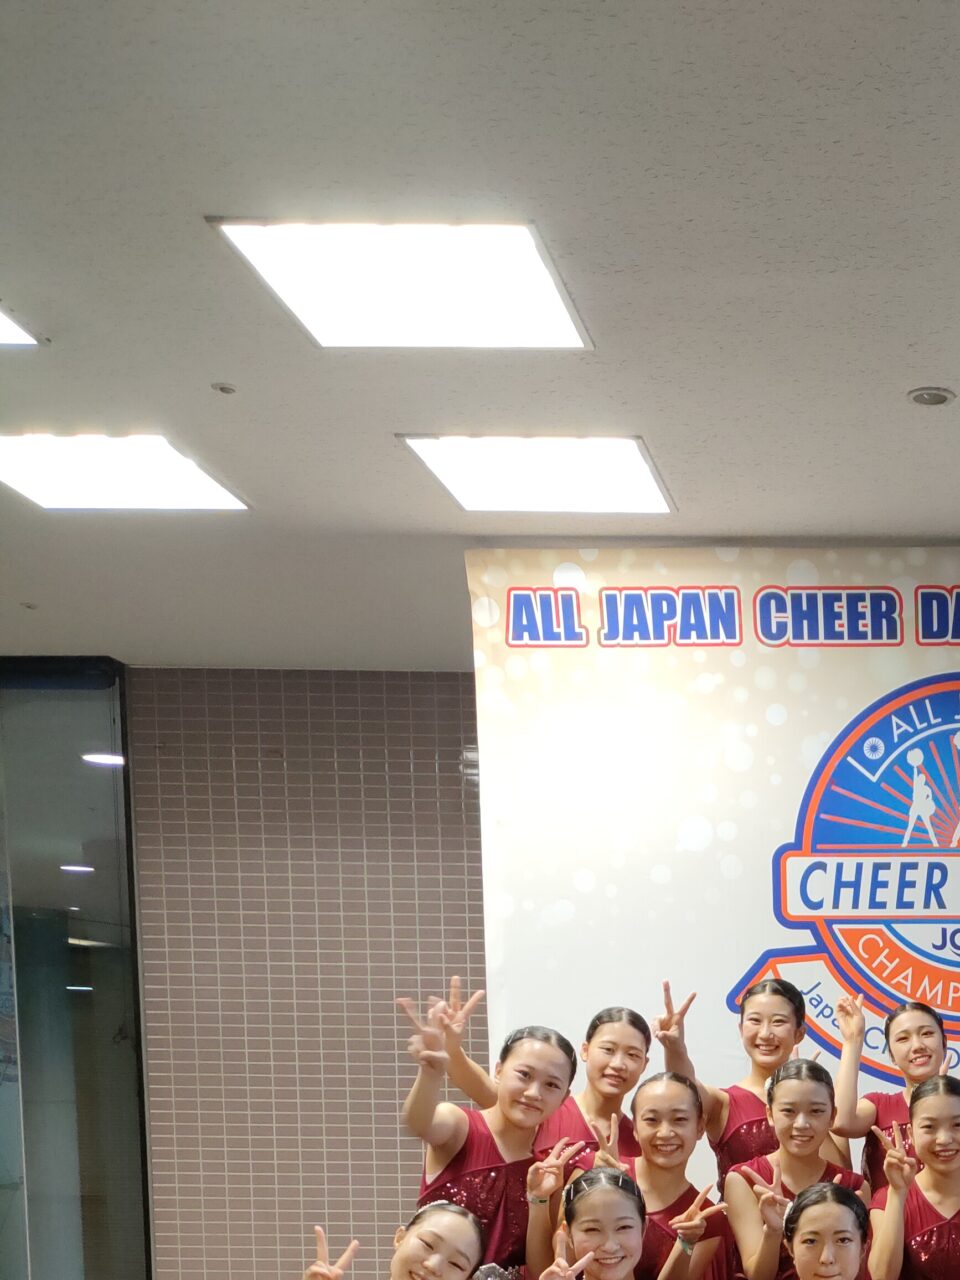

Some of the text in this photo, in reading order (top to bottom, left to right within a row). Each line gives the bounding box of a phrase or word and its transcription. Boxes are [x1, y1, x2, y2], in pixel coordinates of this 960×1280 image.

[509, 590, 586, 645] ALL
[600, 589, 740, 644] JAPAN
[756, 588, 900, 643] CHEER
[891, 699, 942, 743] ALL
[799, 860, 949, 911] CHEER
[801, 980, 841, 1030] Jap
